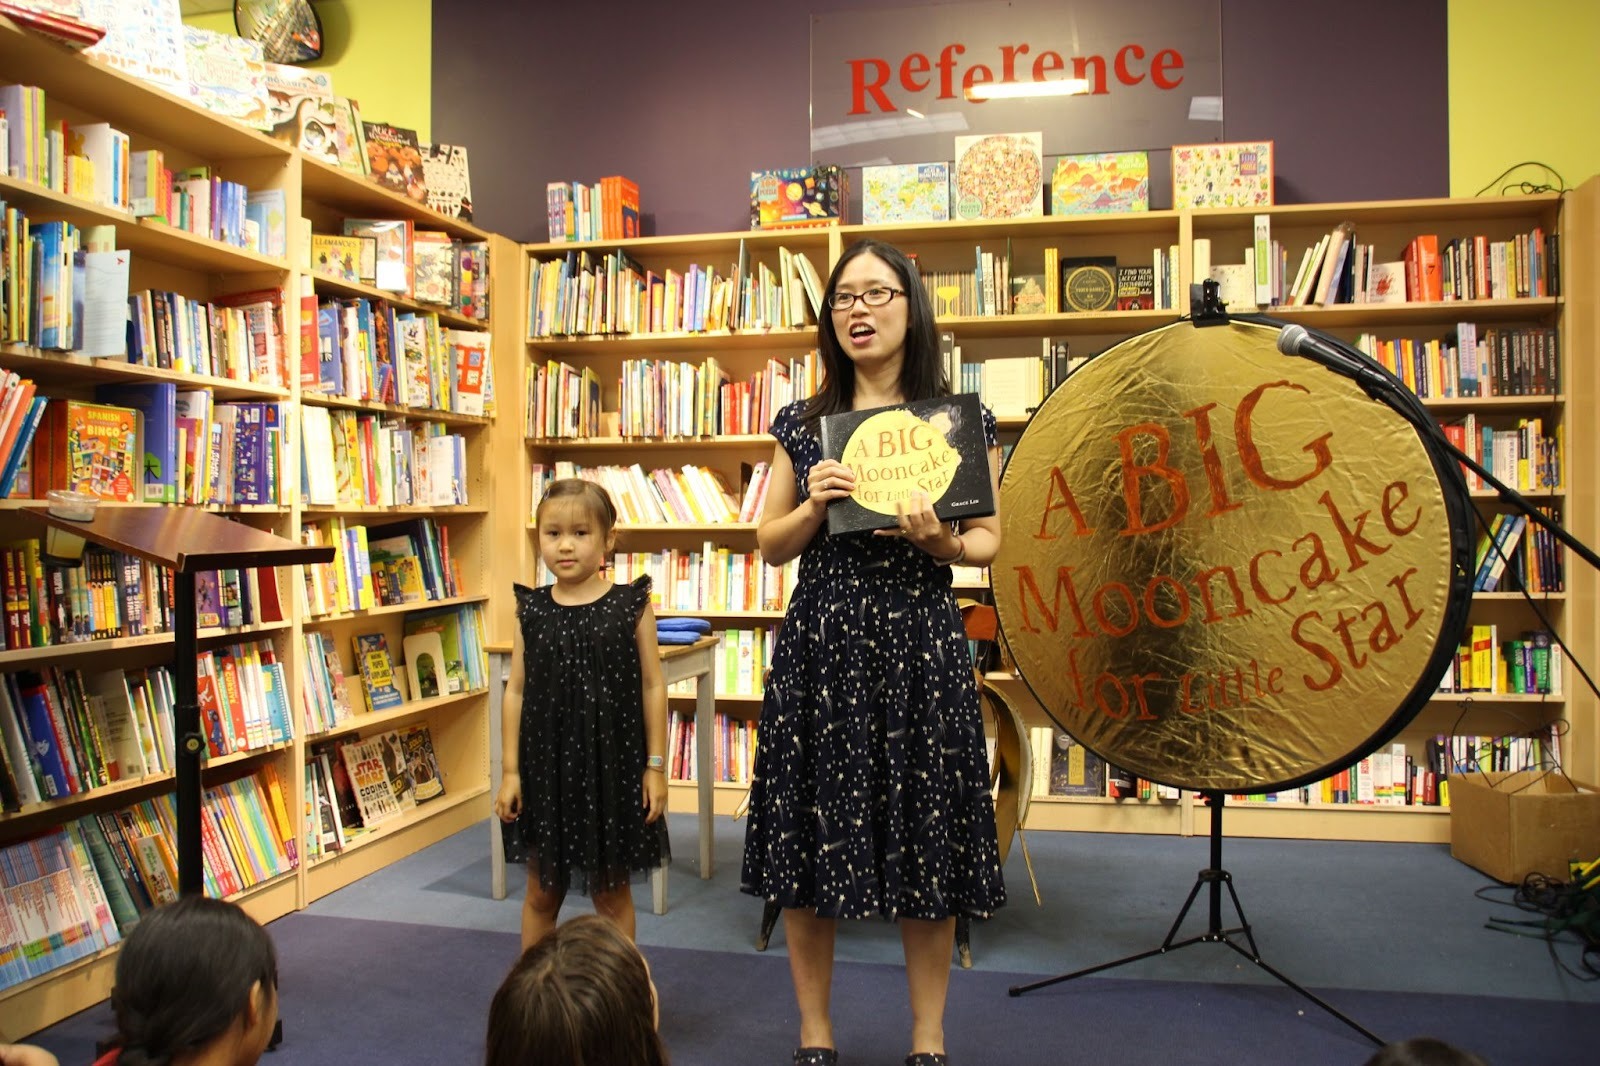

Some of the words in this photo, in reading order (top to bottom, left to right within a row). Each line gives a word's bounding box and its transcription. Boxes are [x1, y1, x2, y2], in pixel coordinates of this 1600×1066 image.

[845, 43, 1185, 116] Reference
[1124, 268, 1138, 276] FIND
[1138, 267, 1152, 275] YOUR
[1118, 280, 1153, 289] DISTURBING
[87, 410, 121, 422] SPANISH
[86, 425, 120, 438] BINGO
[853, 438, 870, 458] A
[878, 425, 934, 458] BIG
[848, 448, 952, 484] Mooncake
[1032, 466, 1095, 540] A
[1112, 379, 1334, 537] BIG
[855, 485, 884, 504] for
[886, 489, 914, 502] Littl
[917, 469, 950, 492] Star
[951, 500, 969, 508] GRACE
[1013, 480, 1424, 639] Mooncake
[126, 595, 134, 622] STARS
[1064, 647, 1160, 721] for
[1178, 659, 1285, 714] Little
[1290, 567, 1426, 692] Star
[225, 671, 236, 705] CURSIVE
[354, 758, 382, 776] STAR
[355, 769, 385, 788] WARS
[359, 780, 389, 797] CODING
[361, 789, 391, 803] PROJECTS
